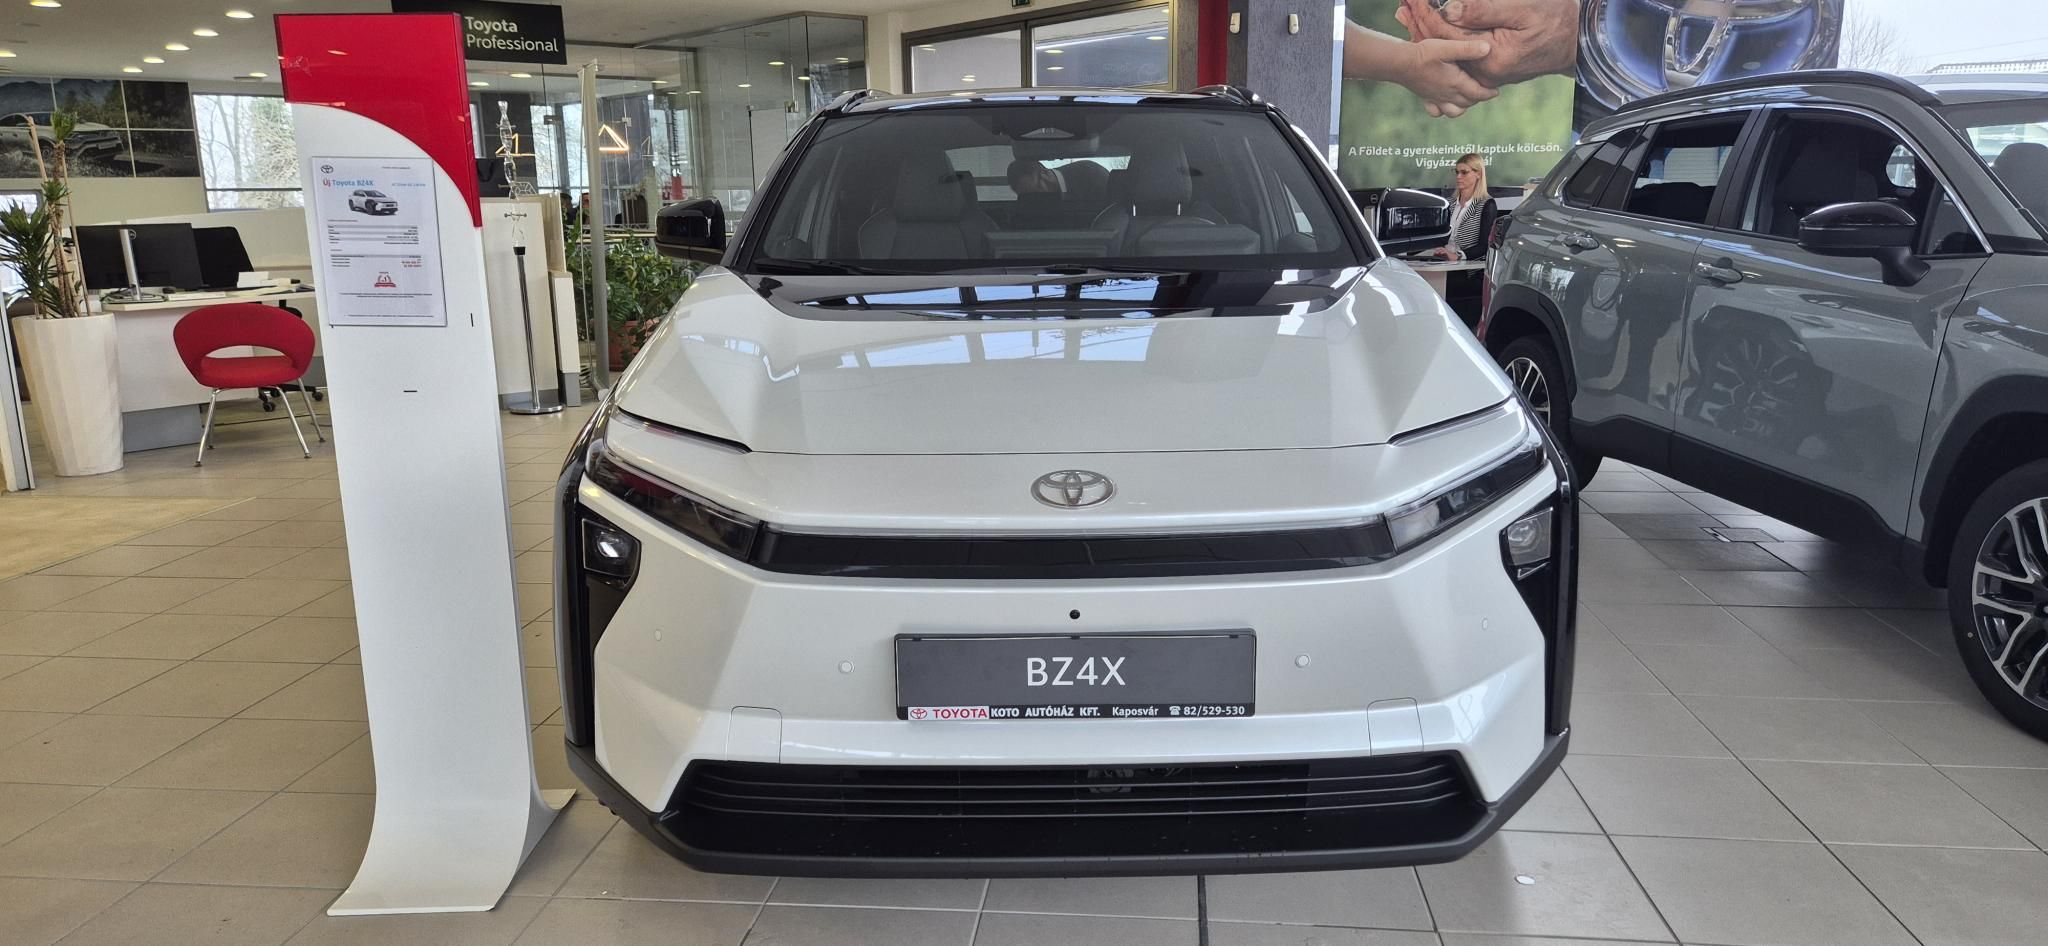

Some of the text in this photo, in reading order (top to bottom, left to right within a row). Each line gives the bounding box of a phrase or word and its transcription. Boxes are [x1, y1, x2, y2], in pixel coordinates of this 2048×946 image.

[464, 16, 518, 34] Toyota
[466, 34, 559, 52] Professional
[1348, 142, 1563, 158] A Földet a gyerekeinktől kaptuk kölcsön.
[332, 179, 356, 187] Toyota
[1027, 656, 1126, 687] BZ4X
[933, 705, 1245, 719] TOYOTA KOTO AUTÓHÁZ KFT. Kaposvár 82/529-530
